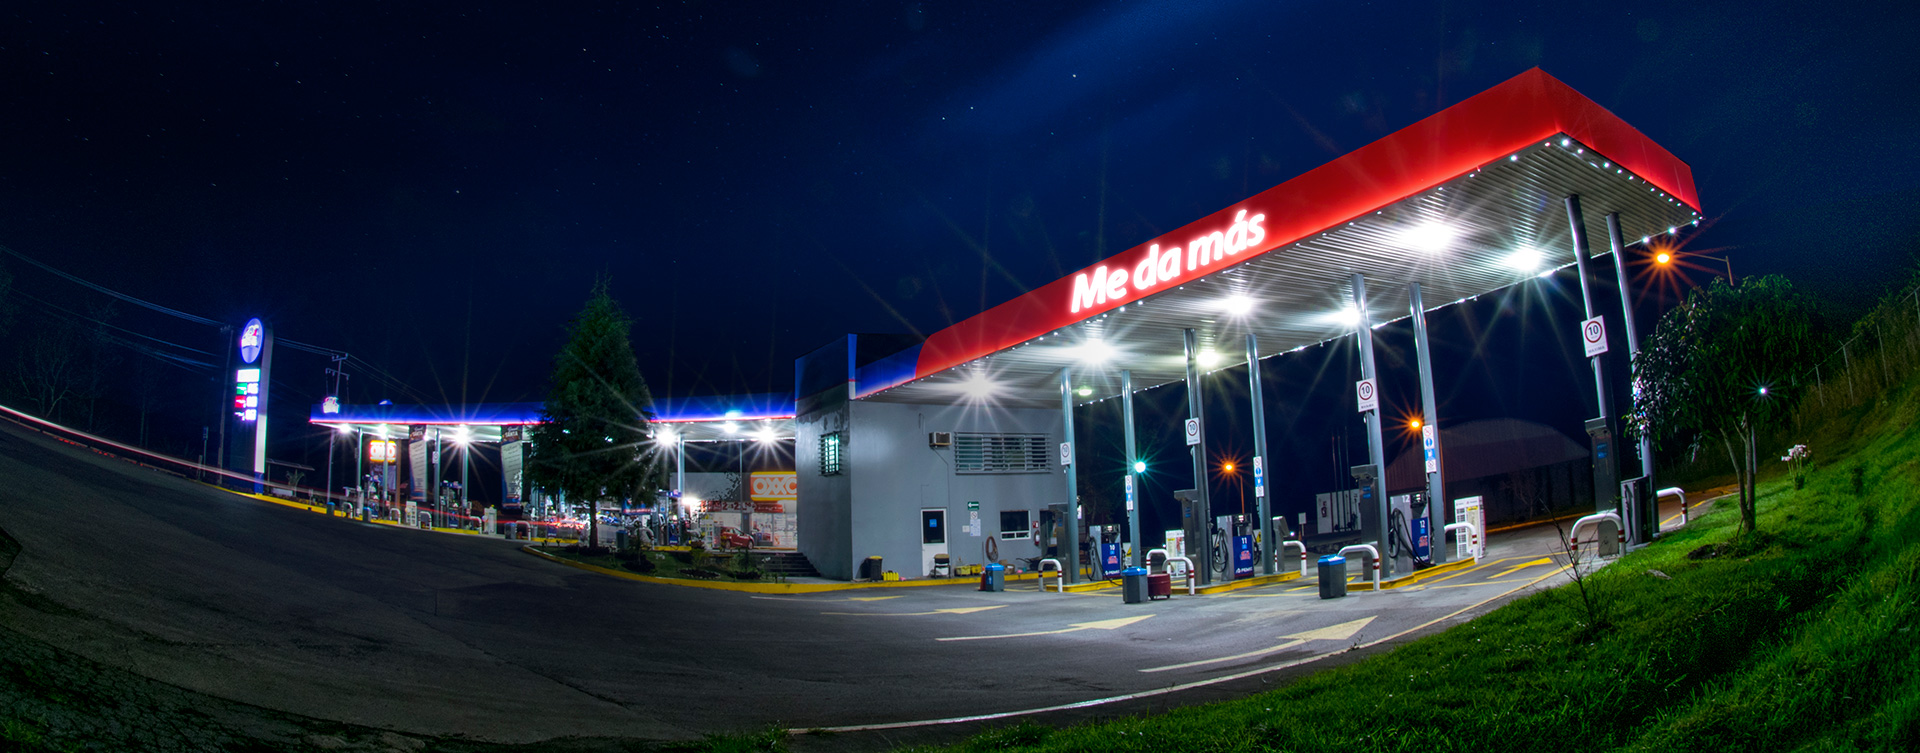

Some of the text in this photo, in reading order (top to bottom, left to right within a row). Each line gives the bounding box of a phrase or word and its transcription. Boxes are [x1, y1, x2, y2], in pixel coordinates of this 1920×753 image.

[1071, 209, 1265, 313] Me da más
[1588, 325, 1598, 335] 10
[1362, 385, 1370, 394] 10
[1402, 494, 1410, 503] 12
[1419, 520, 1425, 528] 12
